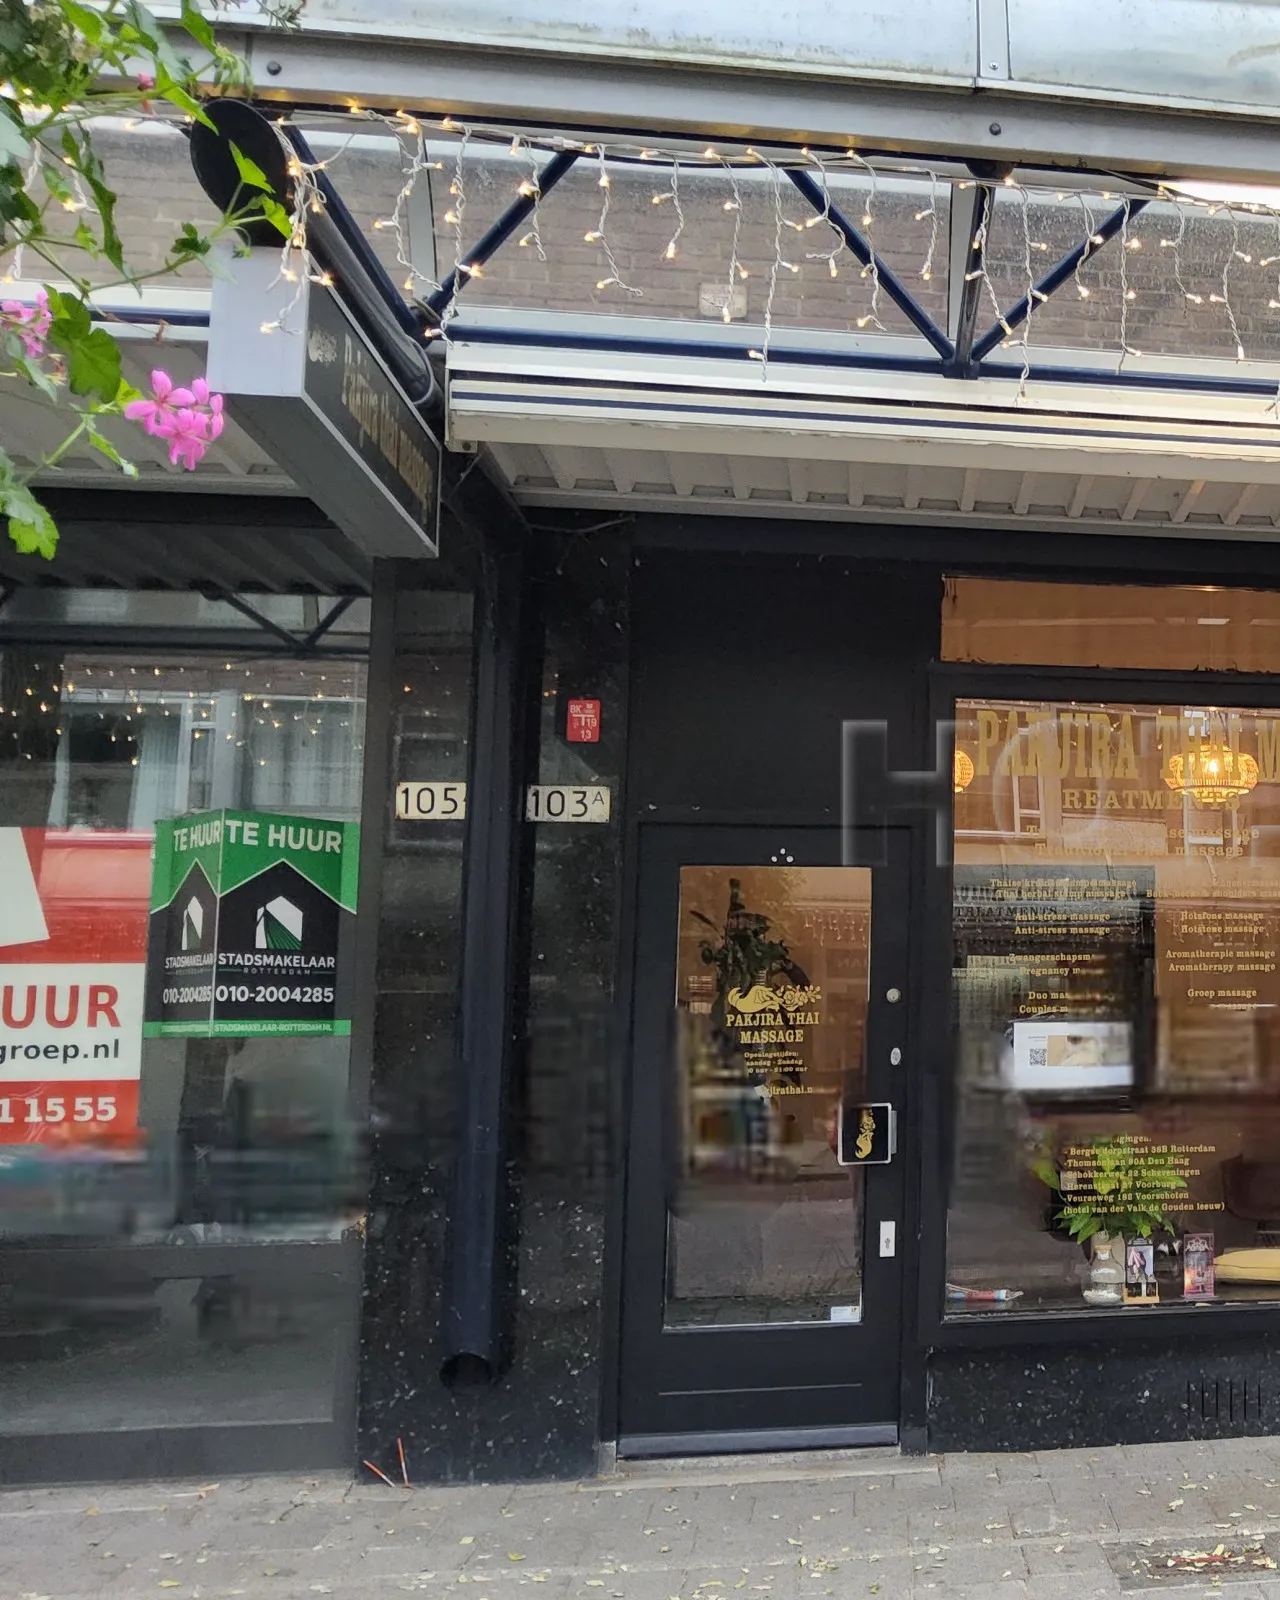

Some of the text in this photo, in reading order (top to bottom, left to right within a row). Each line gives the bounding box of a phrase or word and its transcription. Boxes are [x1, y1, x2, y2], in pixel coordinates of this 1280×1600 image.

[401, 786, 458, 815] 105
[1055, 788, 1241, 811] REATMENTS
[174, 829, 187, 852] TE
[189, 819, 221, 849] HUUR
[225, 819, 342, 854] TE HUUR
[1015, 926, 1111, 937] Anti-stress massage
[1225, 926, 1264, 936] massage
[165, 953, 215, 969] STADSMAKELAAR
[218, 953, 336, 968] STADSMAKELAAR
[1236, 951, 1276, 961] massage
[1169, 963, 1276, 974] Aromatherapy massage
[163, 985, 212, 1004] 010-2004285
[215, 985, 334, 1003] 010-2004285
[1028, 992, 1048, 1000] Duo
[1217, 989, 1257, 999] massage
[726, 1012, 820, 1027] PAKJIRA THAI
[740, 1030, 804, 1044] MASSAGE
[24, 1096, 66, 1123] 15
[73, 1096, 117, 1122] 55
[1170, 1145, 1216, 1153] Rotterdam
[1147, 1157, 1166, 1165] Den
[1168, 1157, 1190, 1167] Haag
[1141, 1169, 1201, 1179] Scheveningen
[1135, 1181, 1176, 1191] Voorburg
[1135, 1192, 1190, 1201] Voorschoten
[1110, 1205, 1125, 1213] der
[1127, 1204, 1147, 1212] Valk
[1149, 1204, 1160, 1212] de
[1161, 1203, 1195, 1212] Gouden
[1197, 1202, 1226, 1212] leeuw)
